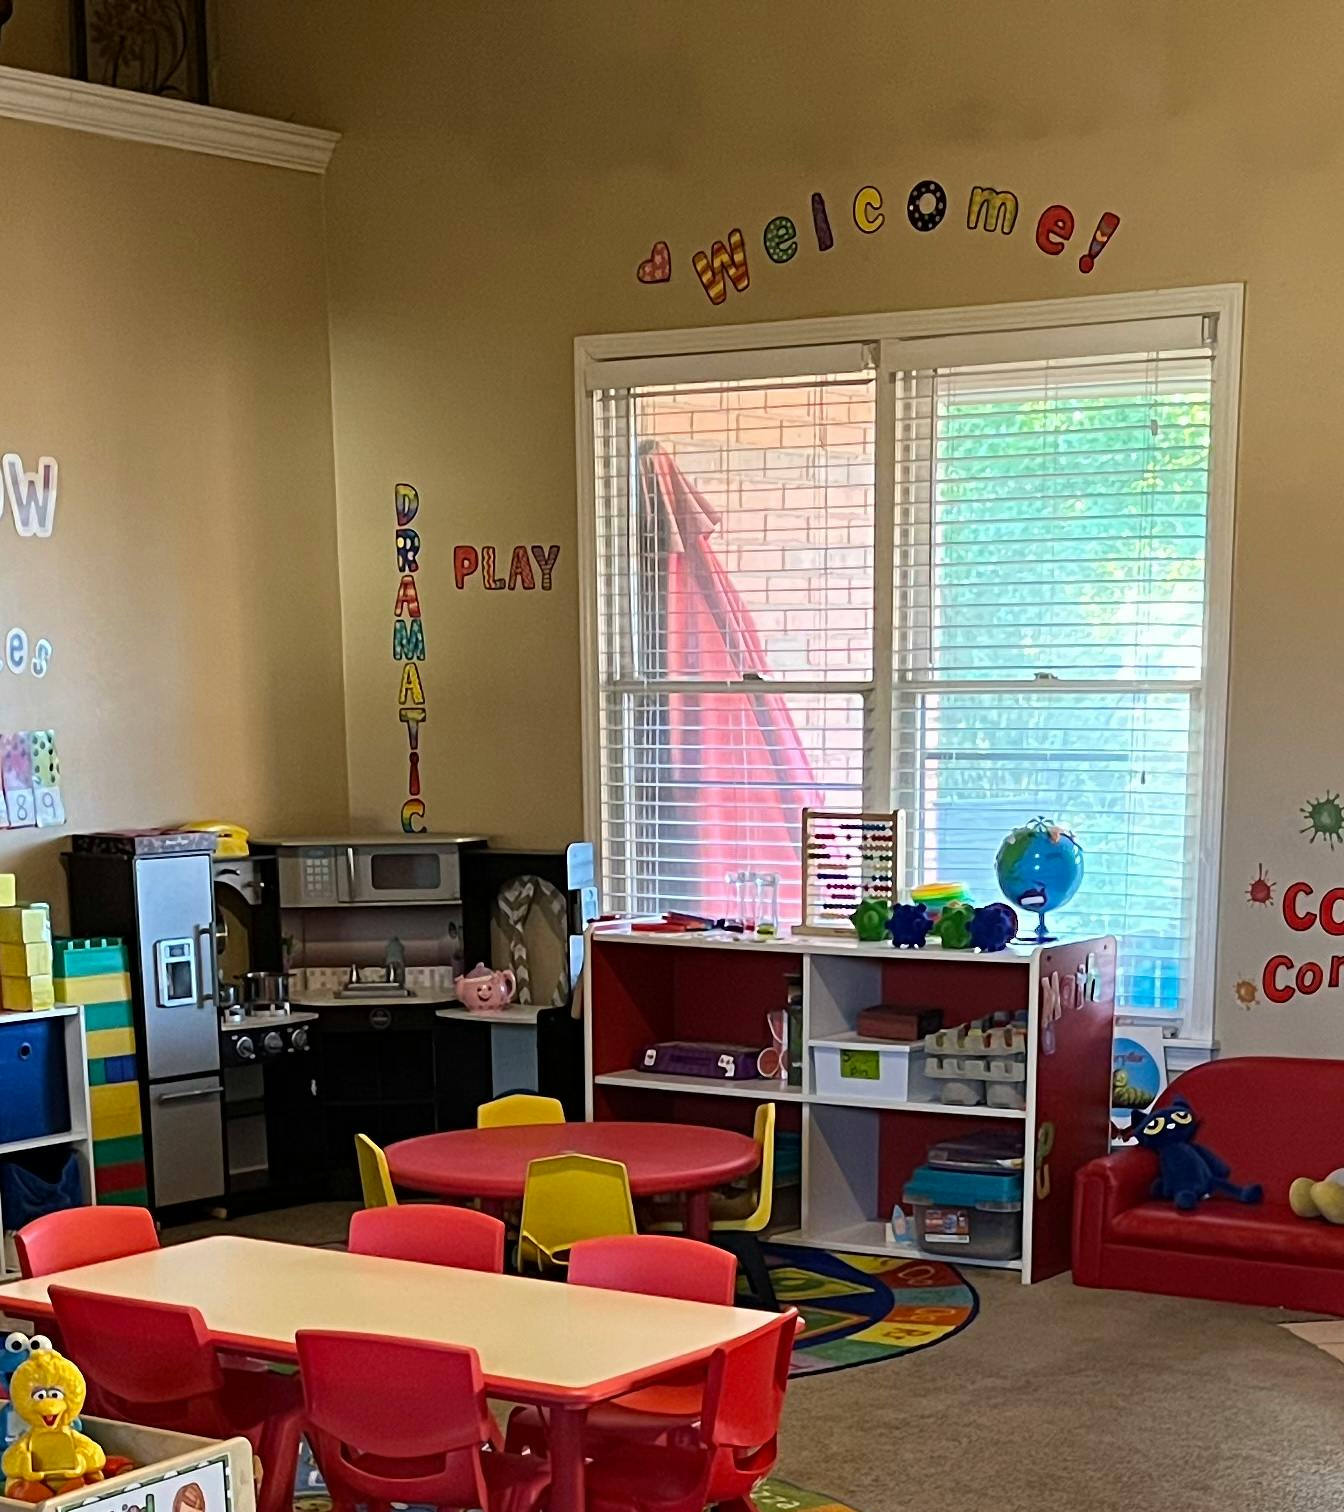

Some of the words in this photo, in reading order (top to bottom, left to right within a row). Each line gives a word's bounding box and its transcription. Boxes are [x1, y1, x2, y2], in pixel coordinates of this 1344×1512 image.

[453, 545, 561, 591] PLAY
[393, 483, 427, 833] DRAMATIC
[15, 793, 29, 821] 8
[41, 791, 56, 818] 9
